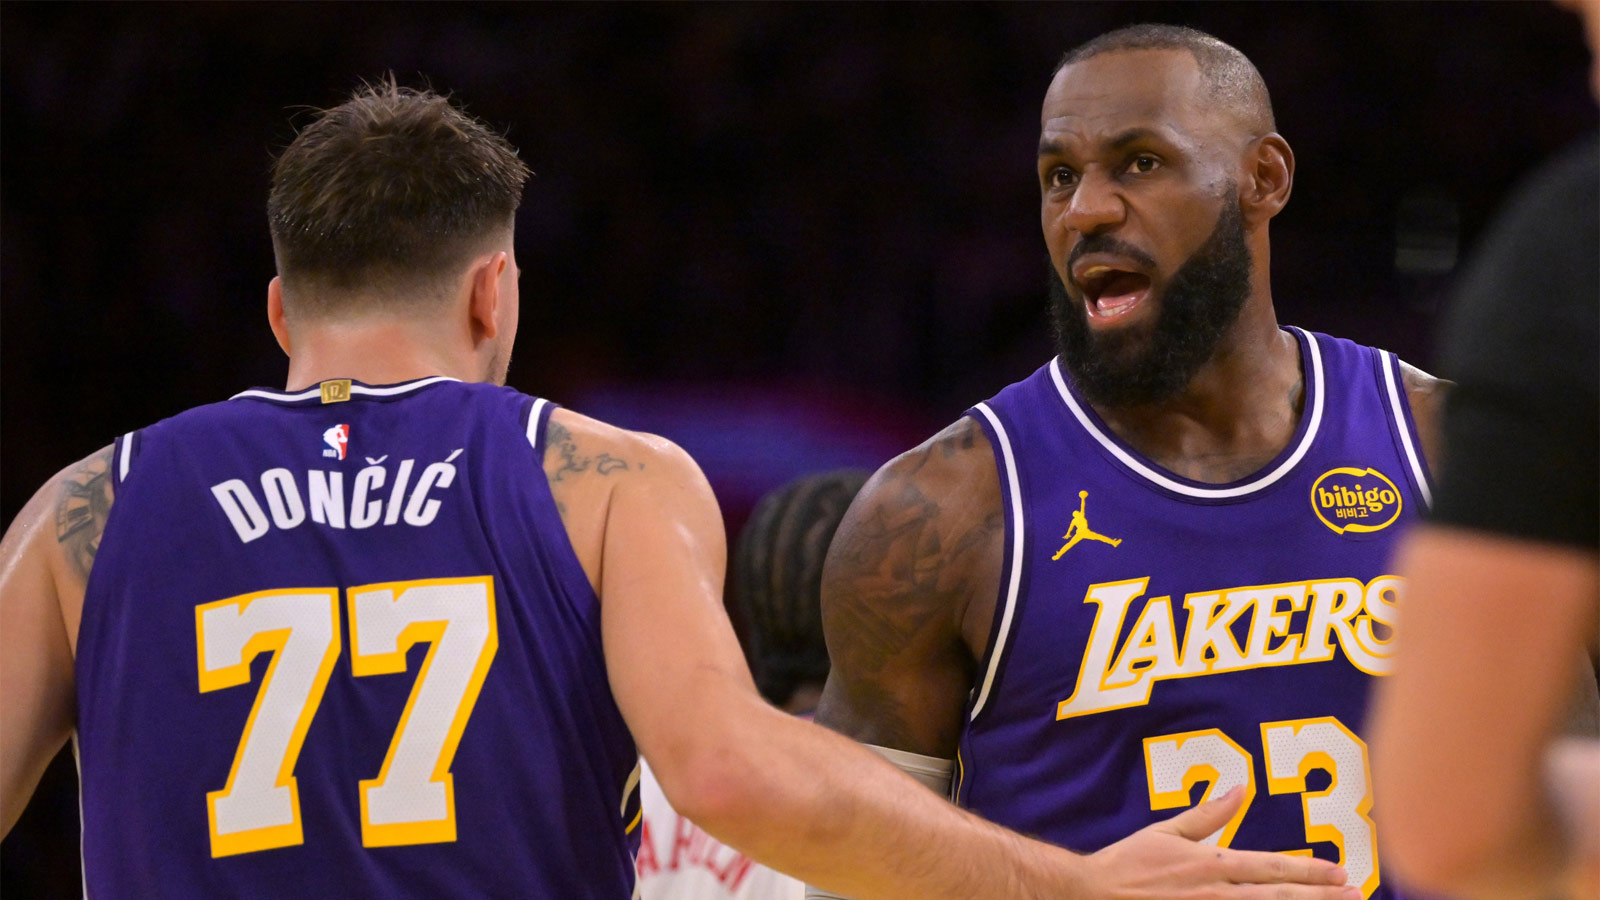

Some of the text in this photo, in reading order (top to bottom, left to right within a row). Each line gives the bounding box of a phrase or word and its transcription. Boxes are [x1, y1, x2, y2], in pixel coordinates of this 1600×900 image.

[210, 448, 465, 544] DONČIĆ
[1318, 484, 1396, 512] bibigo
[1335, 507, 1369, 519] 비비고
[1056, 575, 1406, 721] LAKERS
[195, 575, 499, 859] 77
[1142, 716, 1380, 900] 23
